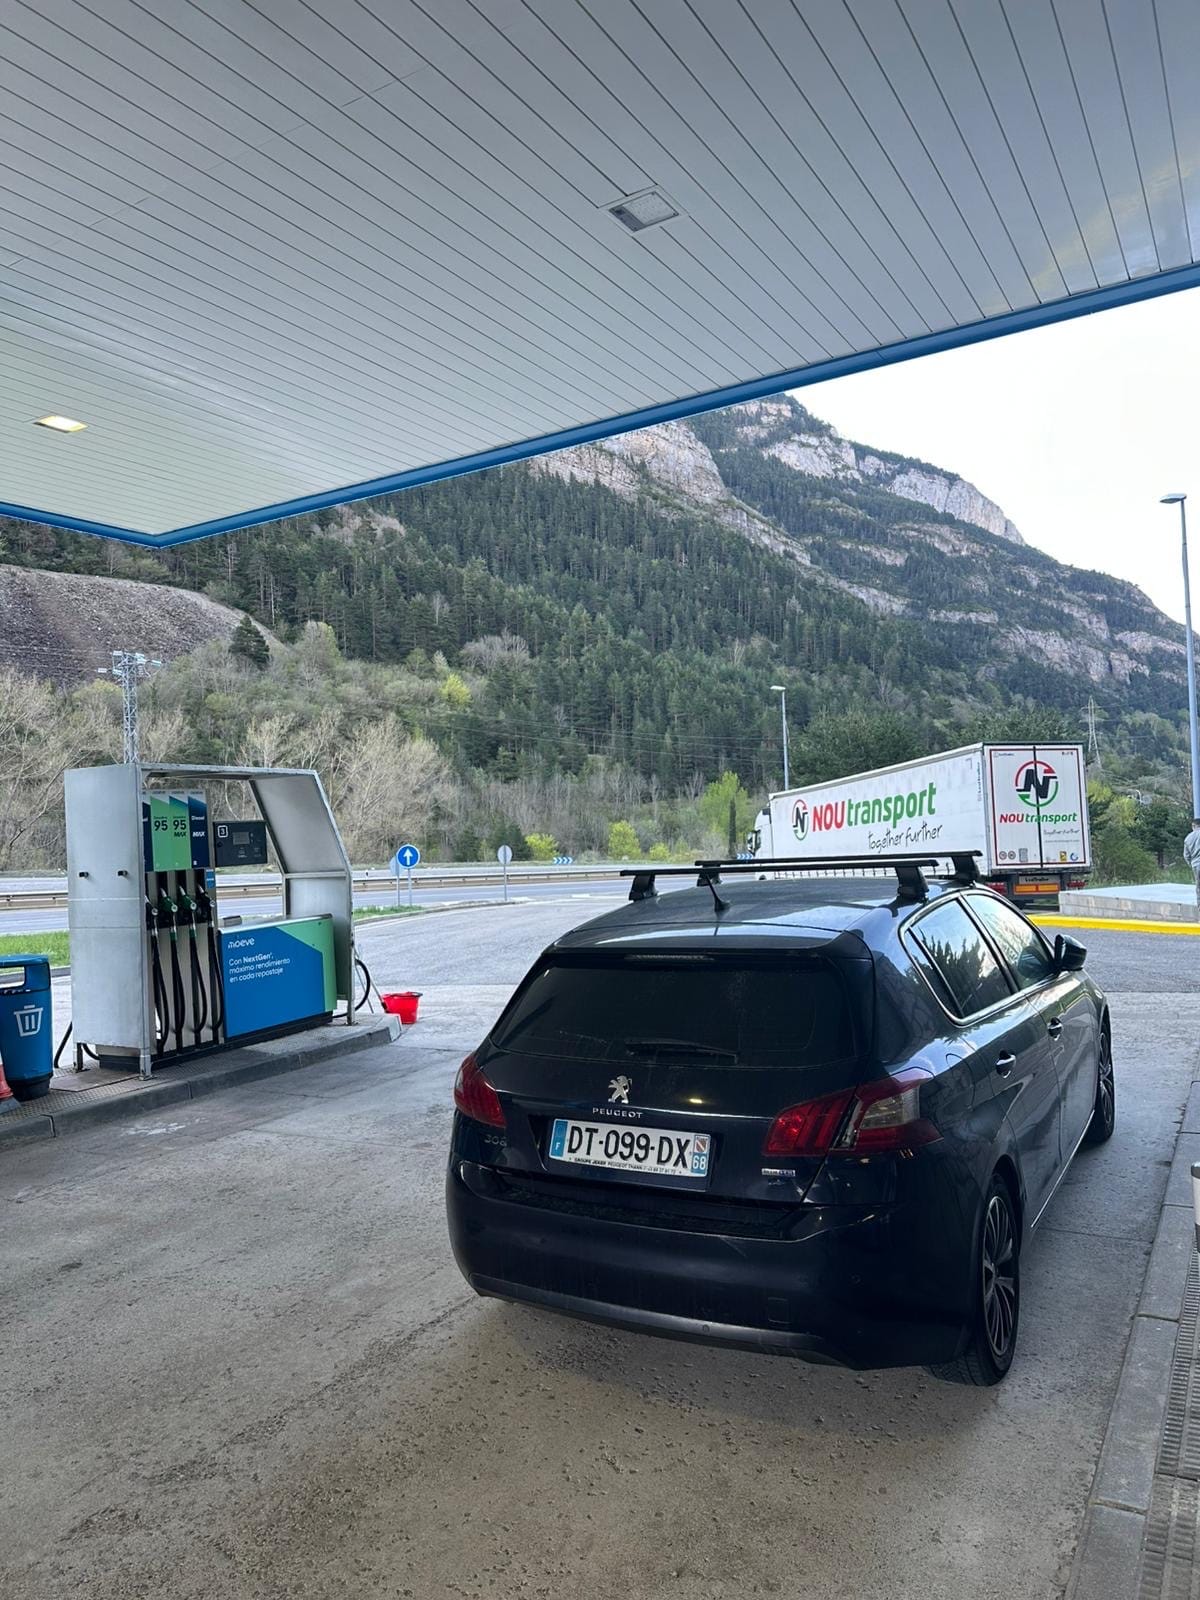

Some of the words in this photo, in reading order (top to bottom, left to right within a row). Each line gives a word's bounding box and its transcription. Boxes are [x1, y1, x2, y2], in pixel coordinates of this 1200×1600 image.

[154, 820, 168, 831] 95
[172, 819, 187, 831] 95
[868, 827, 905, 854] together
[905, 820, 943, 848] further
[227, 937, 255, 949] moeve
[228, 958, 242, 967] Con
[255, 958, 291, 970] rendimiento
[239, 972, 255, 982] cada
[255, 967, 284, 979] repostaje
[592, 1107, 644, 1119] PEUGEOT
[554, 1141, 561, 1150] F
[567, 1125, 691, 1169] DT-099-DX
[692, 1154, 706, 1171] 68
